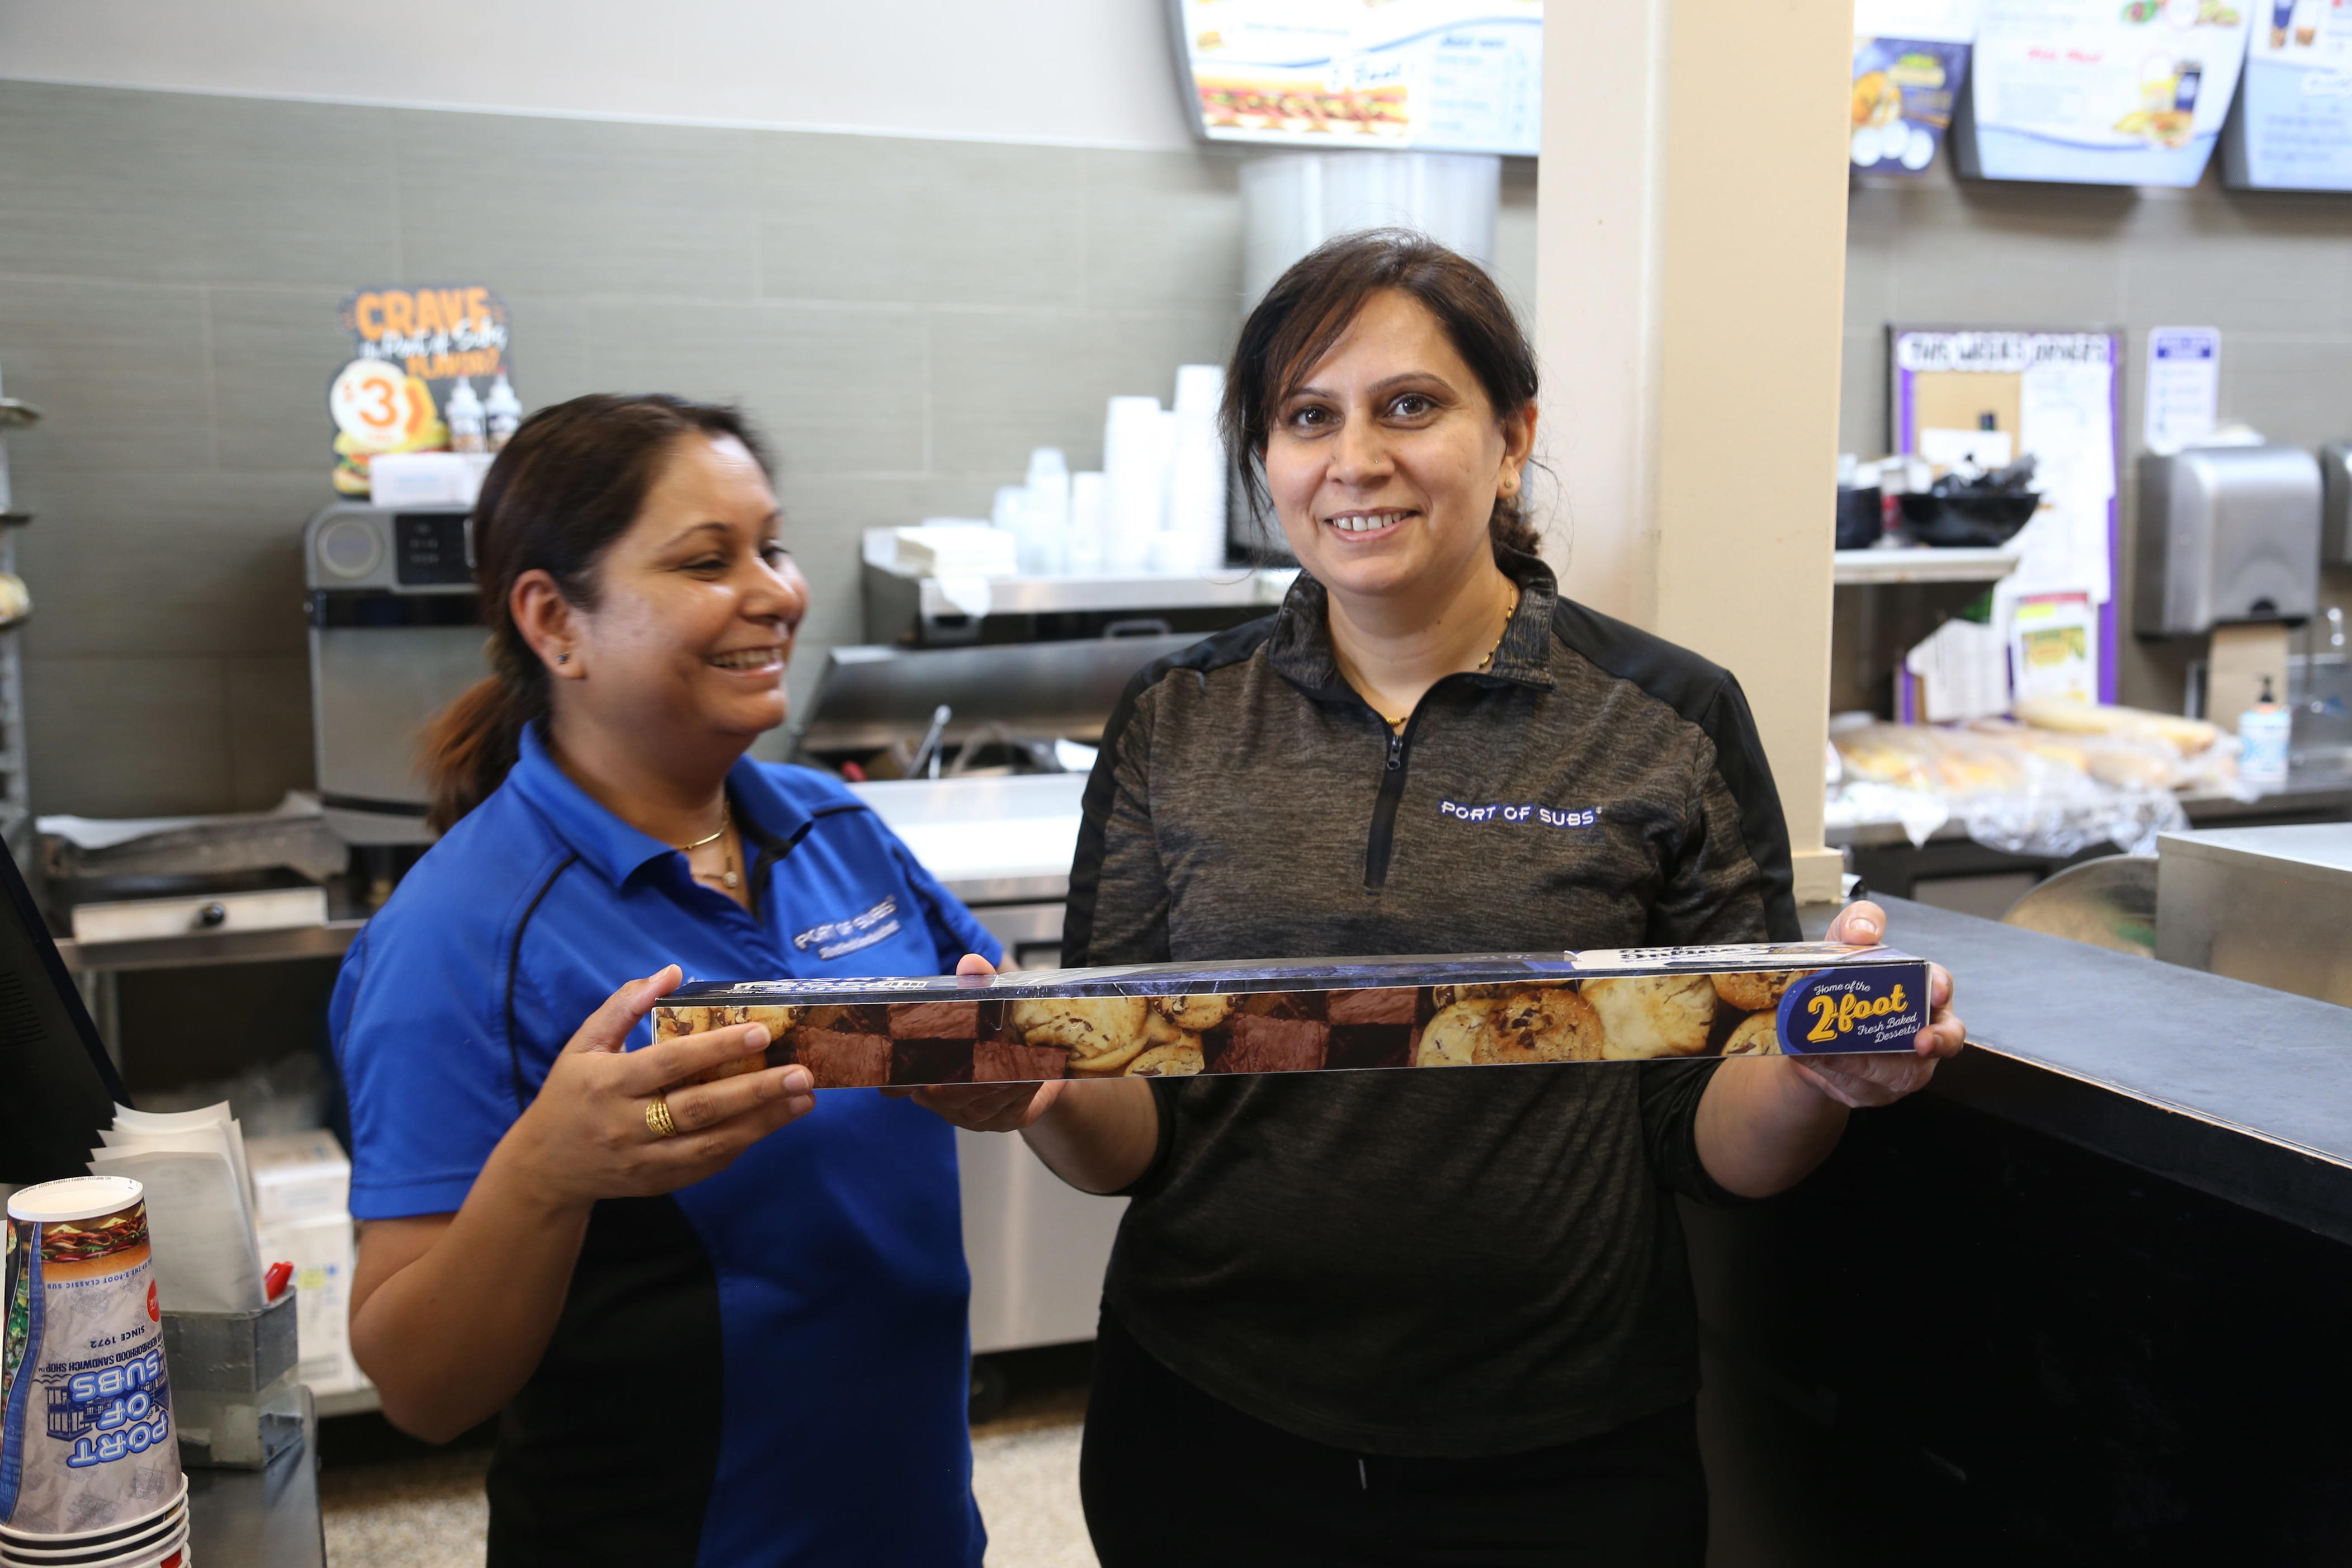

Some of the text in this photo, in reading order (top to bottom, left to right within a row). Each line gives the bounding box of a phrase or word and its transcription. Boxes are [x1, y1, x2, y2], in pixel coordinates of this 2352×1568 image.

[355, 286, 490, 342] CRAVE
[1440, 801, 1497, 821] PORT
[1503, 806, 1532, 822] OF
[1813, 980, 1871, 996] Home of the
[1857, 1012, 1918, 1036] Fresh Baked
[1874, 1022, 1921, 1043] Desserts!
[65, 1278, 100, 1288] CLASSIC
[90, 1336, 116, 1348] 1972
[121, 1325, 145, 1341] SINCE
[116, 1336, 158, 1363] NEIGHBORHOOD
[68, 1355, 115, 1372] SANDWICH
[70, 1350, 160, 1400] SUBS
[98, 1391, 150, 1429] OF
[69, 1412, 168, 1467] PORT
